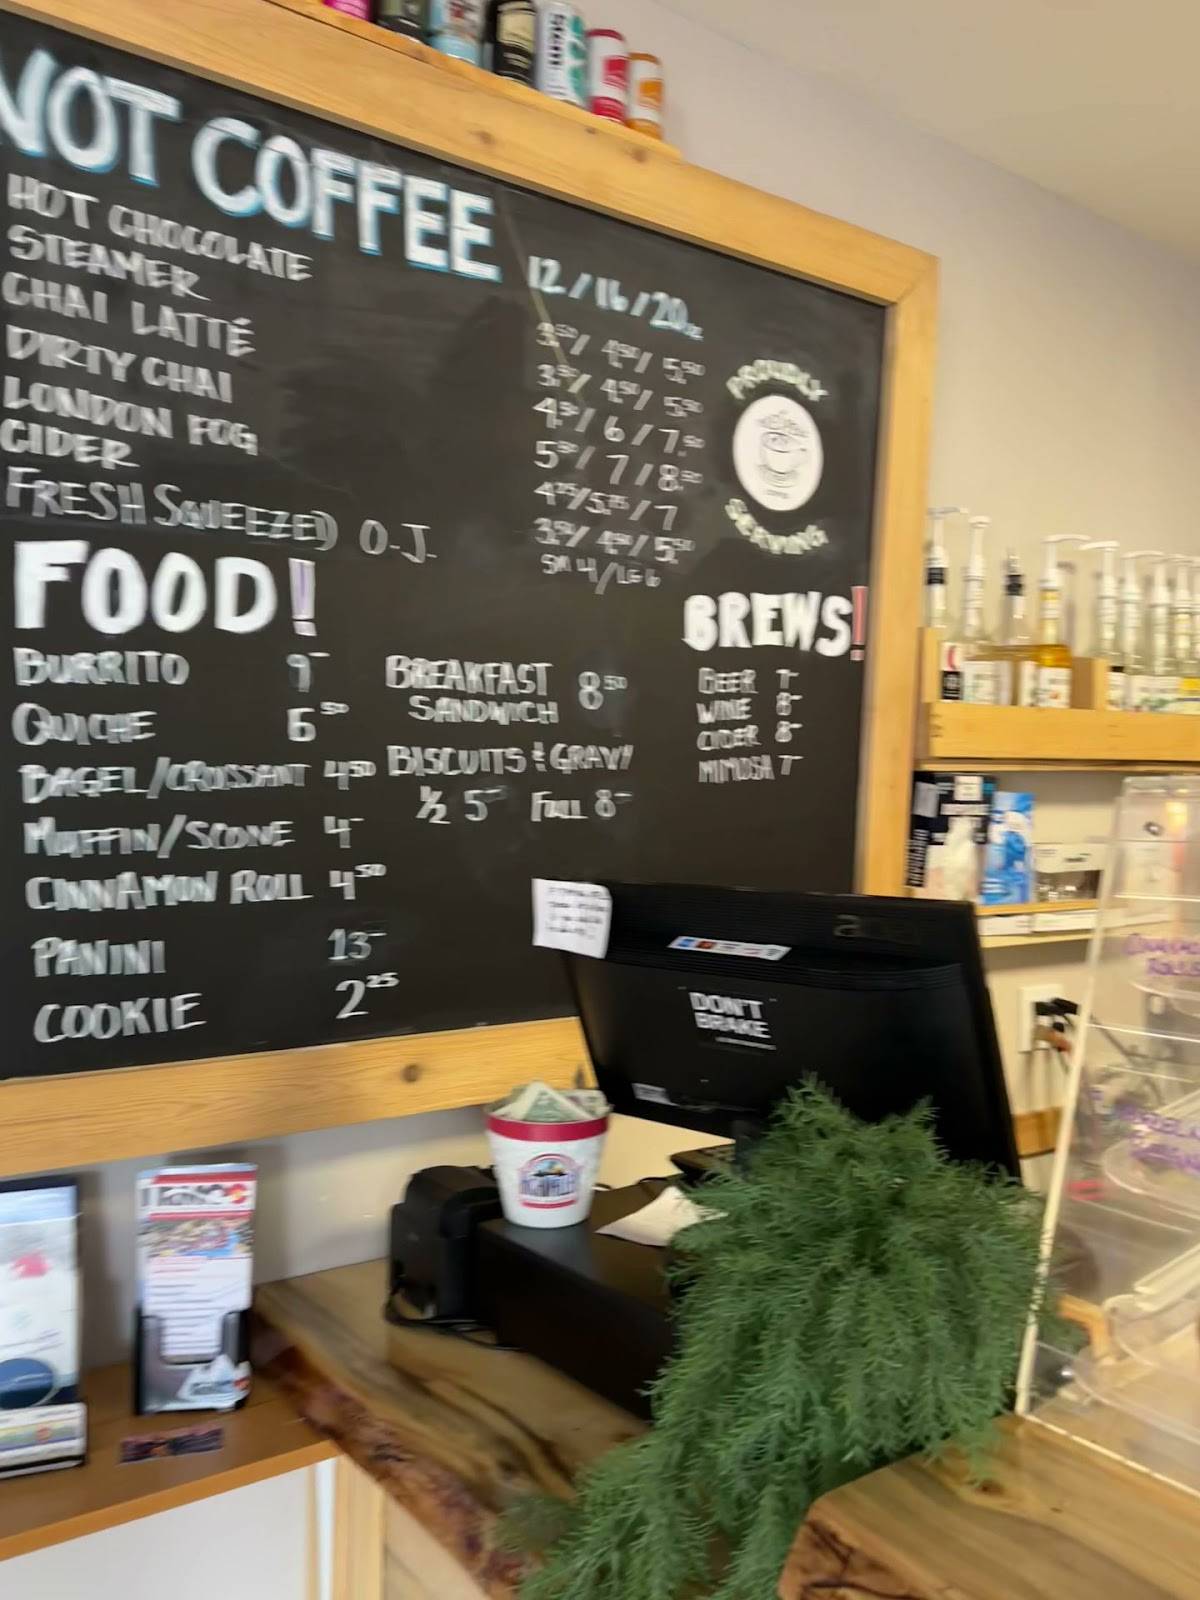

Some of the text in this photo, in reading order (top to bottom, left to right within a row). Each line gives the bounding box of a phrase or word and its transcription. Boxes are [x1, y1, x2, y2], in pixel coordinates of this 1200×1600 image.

[0, 48, 501, 283] NOT COFFEE
[7, 173, 313, 281] HOT CHOCOLATE
[7, 224, 210, 300] STEAMER
[2, 271, 107, 323] CHAI
[6, 324, 233, 403] DIRTY CHAI
[3, 375, 258, 455] LONDON FOG
[0, 418, 140, 469] CIDER
[6, 466, 146, 524] FRESH
[154, 484, 339, 551] SQUEEZED
[681, 586, 868, 660] BREWS!
[13, 647, 190, 686] BURRITO
[386, 655, 553, 695] BREAKFAST
[698, 667, 758, 694] BEER
[12, 702, 157, 745] QUICHE
[408, 695, 559, 725] SANDWICH
[696, 698, 752, 724] WINE
[387, 745, 527, 776] BISCUITS
[550, 743, 634, 774] GRAVY
[697, 725, 762, 751] CIDER
[699, 754, 775, 783] MIMOSA
[25, 871, 218, 911] CINNAMON
[230, 869, 314, 904] ROLL
[31, 937, 166, 977] PANINI
[33, 993, 207, 1043] COOKIE
